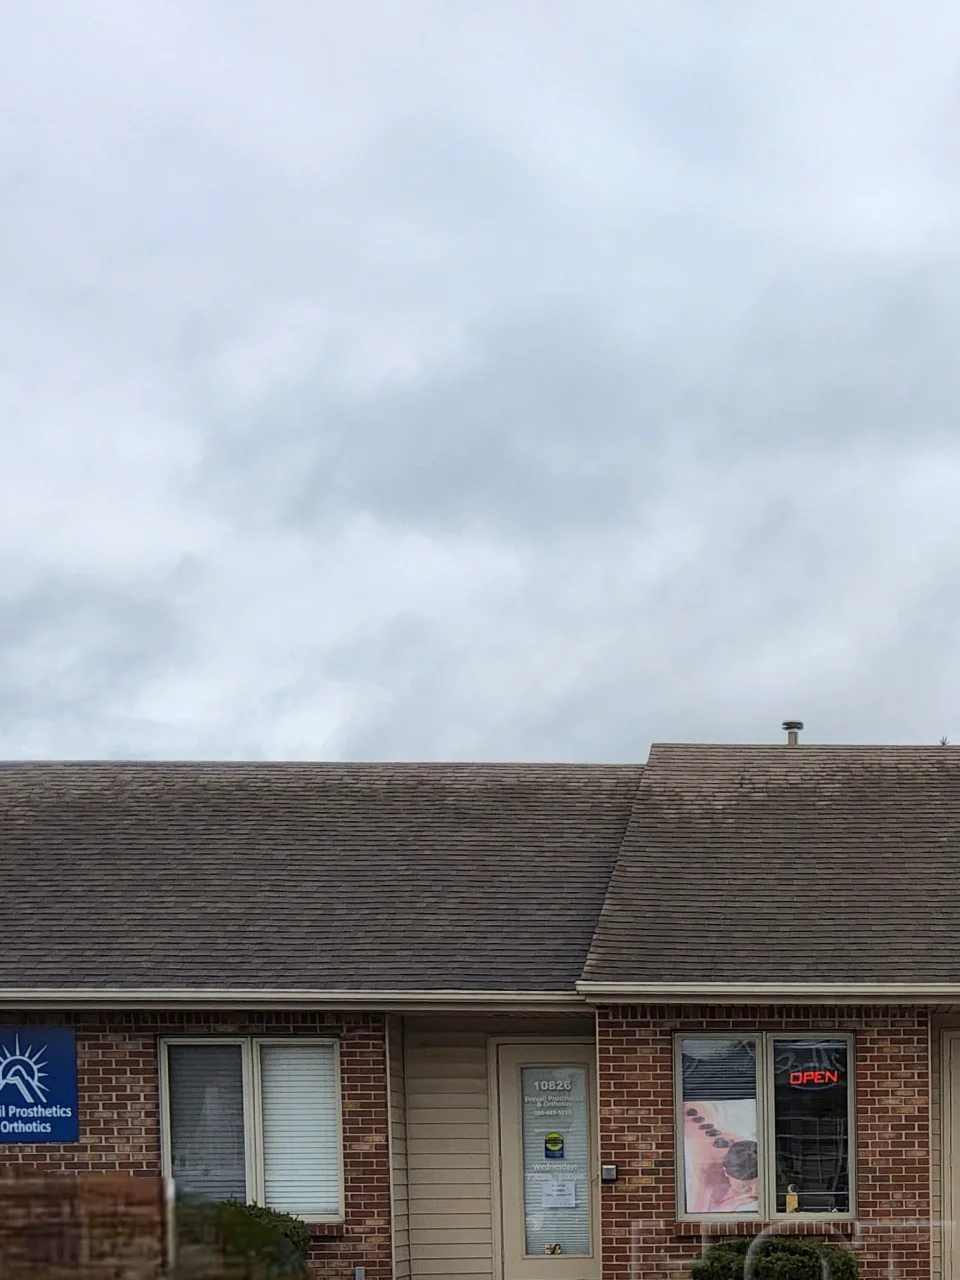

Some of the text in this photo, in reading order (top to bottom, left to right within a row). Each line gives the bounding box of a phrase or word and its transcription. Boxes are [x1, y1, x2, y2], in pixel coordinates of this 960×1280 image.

[789, 1070, 838, 1085] OPEN
[533, 1080, 572, 1091] 10826
[8, 1104, 72, 1117] Prosthetics
[0, 1120, 52, 1133] Orthotics
